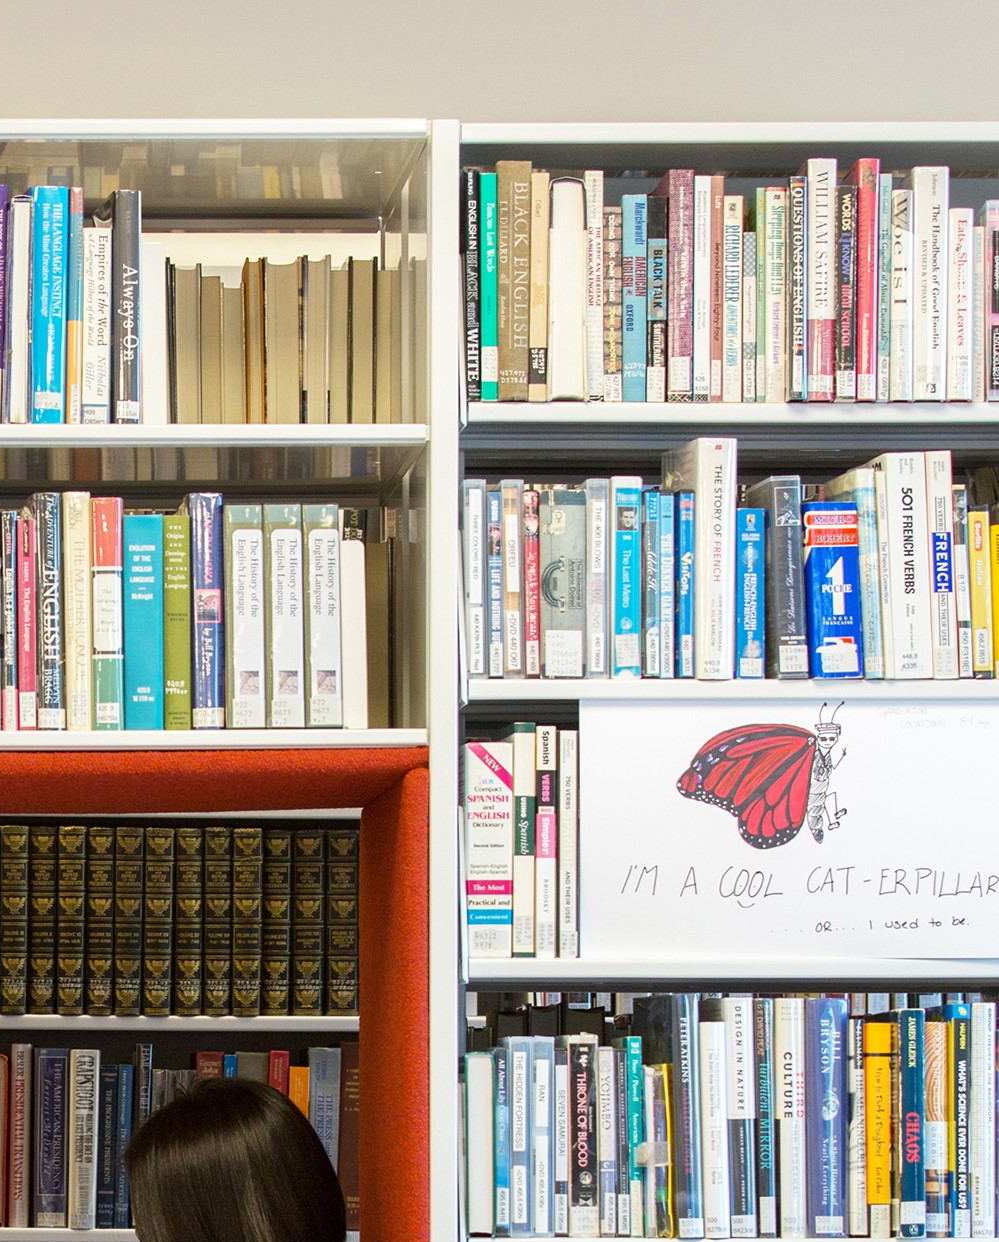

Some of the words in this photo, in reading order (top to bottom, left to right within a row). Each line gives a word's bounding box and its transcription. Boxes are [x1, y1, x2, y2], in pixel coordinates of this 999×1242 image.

[513, 181, 527, 247] BLACK
[815, 170, 828, 245] WILLIAM
[724, 224, 740, 262] RICHARD
[623, 256, 634, 288] ENGLISH
[635, 256, 647, 297] AMERICAN
[652, 249, 662, 279] BLACK
[815, 251, 828, 308] SAFIRE
[122, 264, 139, 329] Always
[652, 283, 662, 309] TALK
[724, 264, 740, 302] LEDERER
[513, 256, 527, 350] ENGLISH
[625, 304, 634, 332] OXFORD
[713, 465, 722, 483] THE
[713, 486, 722, 521] STORY
[901, 487, 913, 508] 501
[713, 524, 722, 542] OF
[813, 515, 854, 524] MICRO
[902, 511, 914, 558] FRENCH
[815, 533, 855, 543] ROBERT
[712, 545, 722, 583] FRENCH
[903, 560, 916, 595] VERBS
[934, 533, 948, 592] FRENCH
[822, 584, 852, 594] POCHE
[542, 731, 550, 765] Spanish
[467, 795, 509, 803] SPANISH
[474, 786, 502, 794] Compact
[541, 774, 550, 802] VERBS
[467, 812, 510, 820] ENGLISH
[472, 821, 504, 830] Dictionary
[541, 817, 550, 855] Simpler
[472, 884, 485, 892] The
[487, 884, 505, 892] Most
[621, 865, 658, 895] I'M
[680, 866, 697, 897] A
[718, 866, 783, 898] COOL
[469, 913, 508, 921] Convenient
[884, 918, 919, 930] used
[928, 917, 942, 928] to
[576, 1072, 588, 1117] THRONE
[783, 1052, 793, 1119] CULTURE
[576, 1118, 588, 1131] OF
[905, 1111, 920, 1163] CHAOS
[576, 1133, 589, 1167] BLOOD
